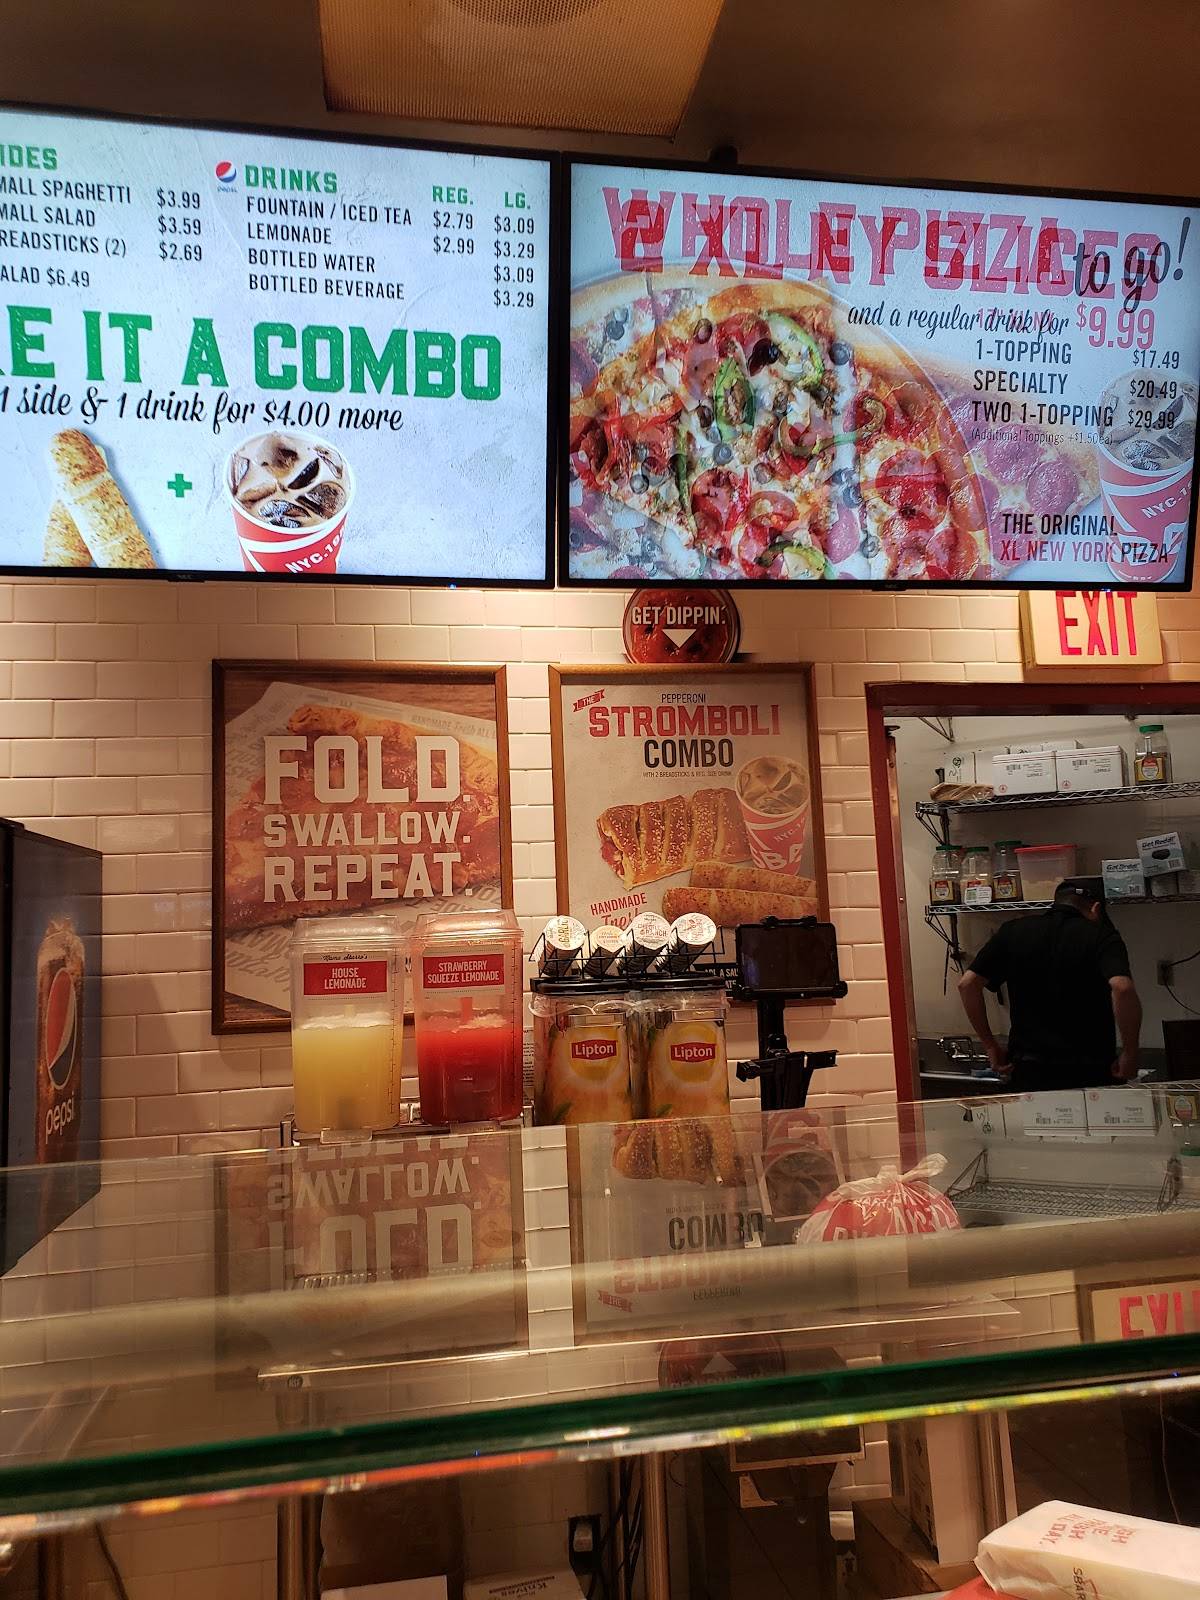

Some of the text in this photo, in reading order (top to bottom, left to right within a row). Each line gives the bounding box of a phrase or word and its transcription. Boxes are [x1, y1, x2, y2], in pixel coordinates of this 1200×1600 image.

[245, 165, 337, 193] DRINKS
[43, 180, 131, 204] SPAGHETTI
[157, 188, 201, 209] $3.99
[433, 185, 531, 209] REG. LG.
[44, 206, 96, 227] SALAD
[247, 197, 325, 219] FOUNTAIN
[342, 205, 378, 223] ICED
[384, 208, 412, 225] TEA
[433, 210, 535, 234] $2.79 $3.09
[158, 216, 202, 236] $3.59
[248, 222, 332, 244] LEMONADE
[105, 239, 127, 258] (2)
[159, 242, 202, 262] $2.69
[433, 236, 535, 259] $2.99 $3.29
[248, 248, 376, 273] BOTTLED WATER
[1073, 217, 1191, 313] to go!
[46, 267, 90, 288] $6.49
[493, 265, 535, 284] $3.09
[249, 273, 405, 300] BOTTLED BEVERAGE
[493, 289, 535, 308] $3.29
[847, 301, 884, 326] and
[889, 307, 902, 327] a
[907, 303, 980, 340] regular
[1075, 301, 1155, 350] $9.99
[0, 304, 501, 401] E IT A COMBO
[976, 339, 1180, 370] 1-TOPPING $17.49
[973, 369, 1177, 400] SPECIALTY $20.49
[17, 383, 72, 415] side
[80, 386, 108, 425] &
[117, 392, 128, 418] 1
[136, 389, 206, 422] drink
[213, 391, 254, 434] for
[263, 400, 330, 428] $4.00
[338, 408, 403, 431] more
[971, 400, 1175, 430] TWO 1-TOPPING $29.99
[1024, 430, 1065, 446] Toppings
[1001, 513, 1118, 536] THE ORIGINAL
[1000, 540, 1168, 563] XL NEW YORK PIZZA
[632, 606, 661, 625] GET
[1055, 591, 1137, 655] EXIT
[661, 693, 706, 704] PEPPERONI
[589, 704, 781, 737] STROMBOLI
[644, 738, 734, 769] COMBO
[263, 735, 471, 804] FOLD.
[263, 811, 471, 848] SWALLOW.
[263, 852, 473, 903] REPEAT.
[590, 892, 648, 915] HANDMADE
[332, 967, 360, 978] HOUSE
[427, 971, 500, 983] SQUEEZE LEMONADE
[438, 960, 488, 972] STRAWBERRY
[324, 978, 367, 990] LEMONADE
[575, 1043, 613, 1058] Lipton
[674, 1046, 712, 1060] Lipton
[45, 1093, 74, 1144] pepsi
